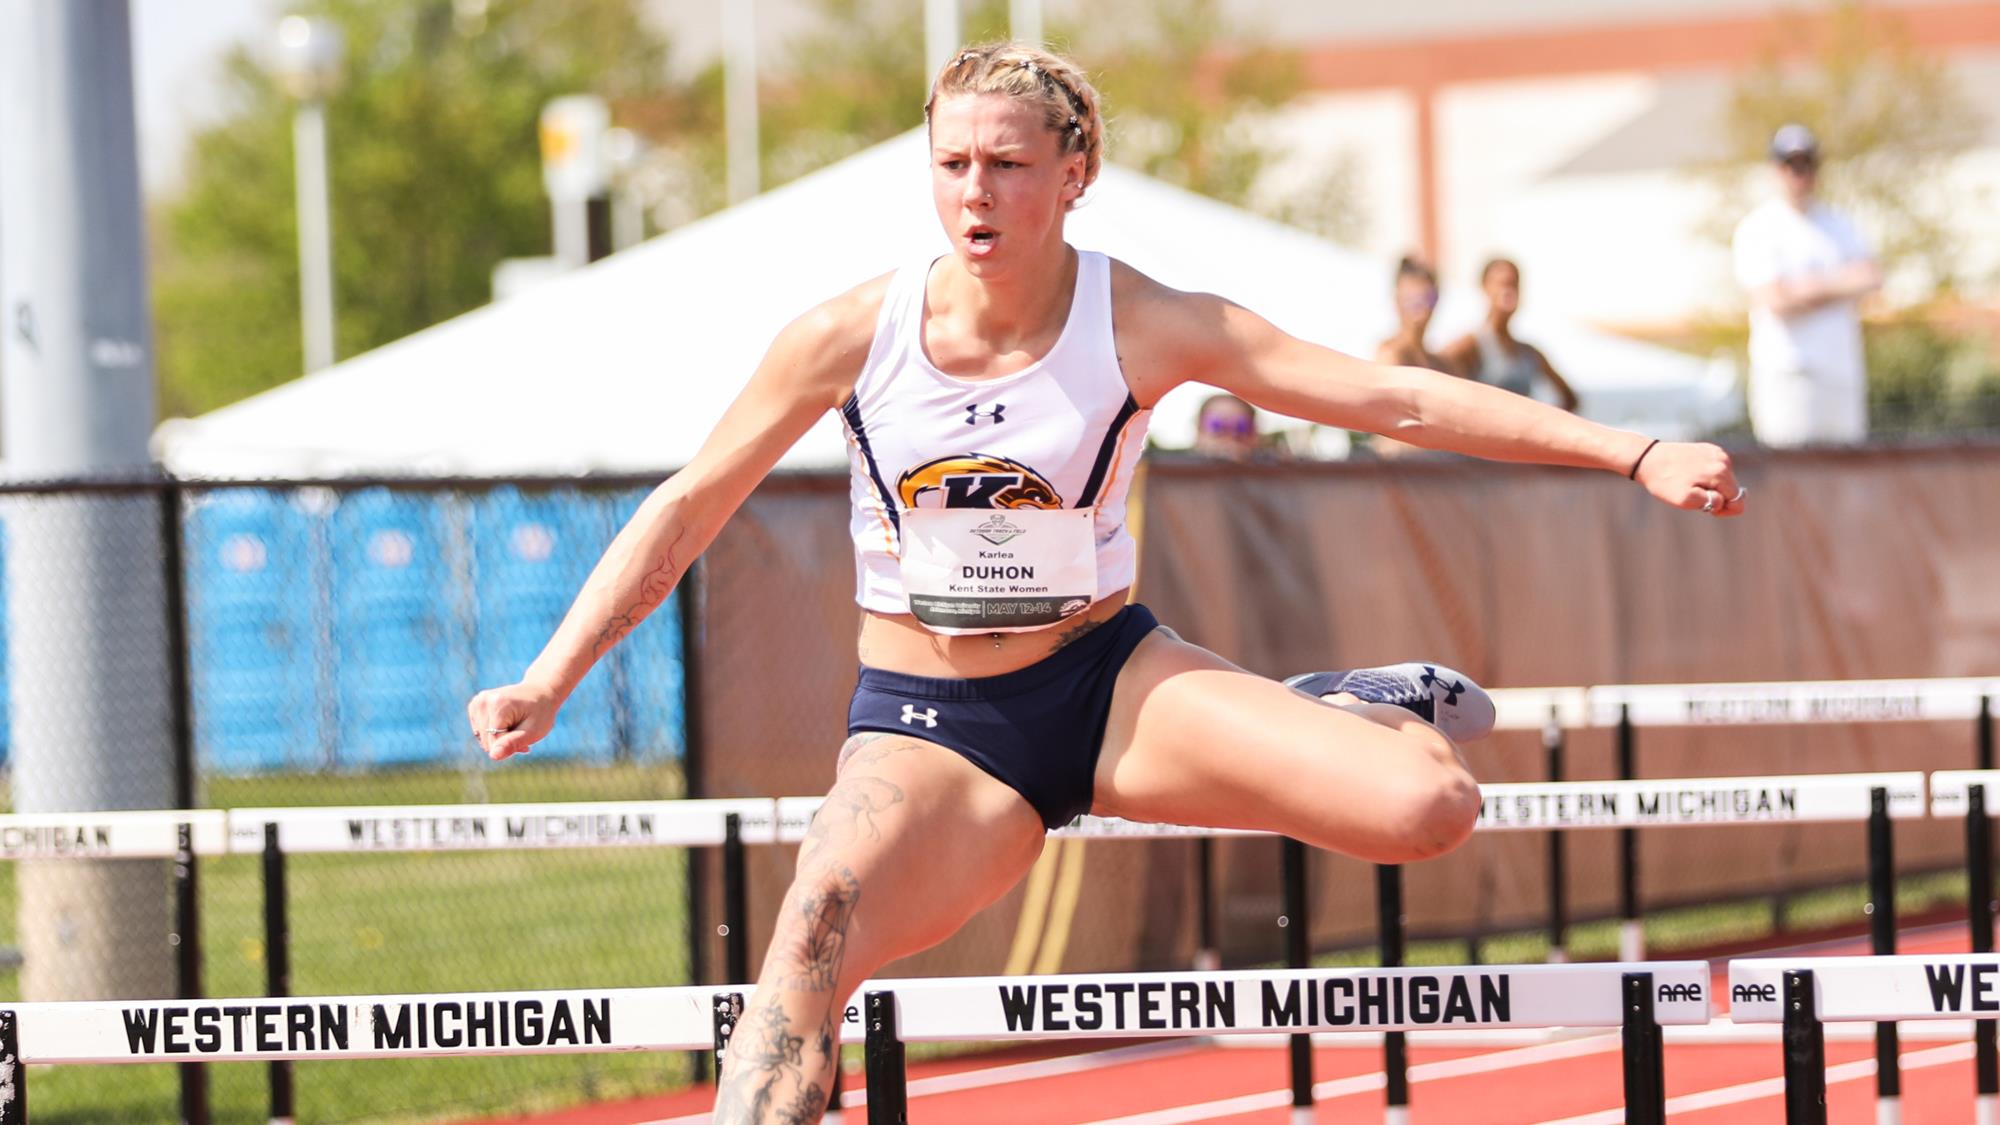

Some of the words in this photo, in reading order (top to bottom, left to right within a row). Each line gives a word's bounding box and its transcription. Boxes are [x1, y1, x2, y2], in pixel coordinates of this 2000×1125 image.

[979, 551, 1014, 559] Karlea
[963, 566, 1034, 579] DUHON
[949, 584, 973, 593] Kent
[977, 584, 1006, 593] State
[1009, 585, 1048, 593] Women
[987, 602, 1018, 615] MAY
[1020, 602, 1052, 614] 12-14
[1637, 788, 1797, 816] MICHIGAN
[347, 818, 487, 845] WESTERN
[504, 814, 656, 842] MICHIGAN
[1925, 963, 2000, 1012] WE
[999, 980, 1236, 1031] WESTERN
[1261, 973, 1511, 1027] MICHIGAN
[122, 1005, 348, 1054] WESTERN
[373, 998, 611, 1049] MICHIGAN
